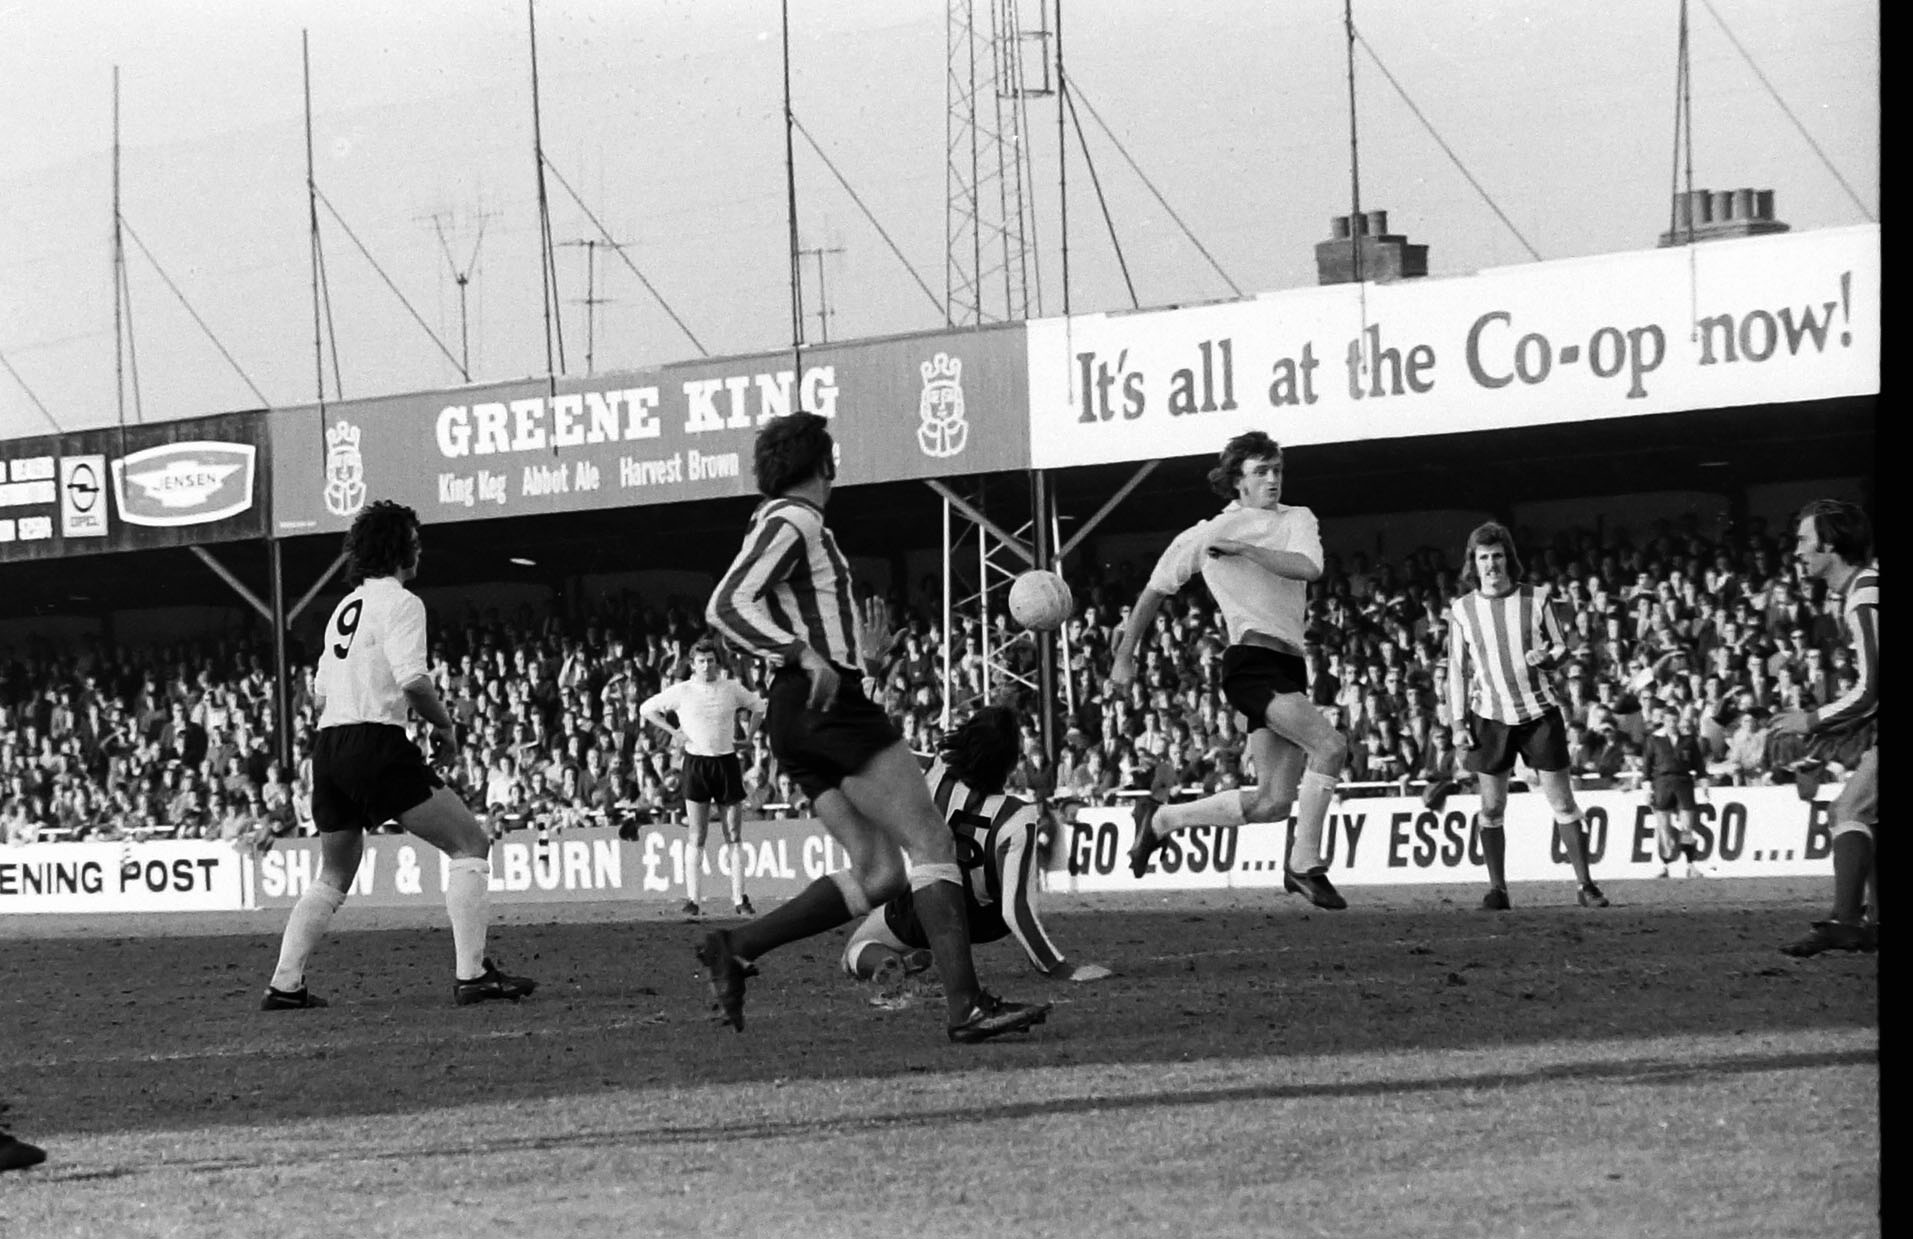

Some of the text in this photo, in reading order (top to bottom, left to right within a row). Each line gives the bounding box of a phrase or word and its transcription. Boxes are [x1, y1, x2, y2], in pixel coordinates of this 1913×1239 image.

[1077, 270, 1852, 423] It's all at the Co-op now!
[436, 366, 839, 458] GREENE KING
[438, 449, 739, 507] King Keg Abbot Ale Harvest Brown
[333, 598, 363, 660] 9
[262, 847, 377, 897] SHW
[395, 845, 423, 894] &
[439, 839, 622, 892] LBURN
[803, 834, 852, 880] CL
[1069, 822, 1118, 876] GO
[1143, 825, 1276, 875] SSO...
[1284, 813, 1366, 871] UY
[0, 858, 219, 895] ENING POST
